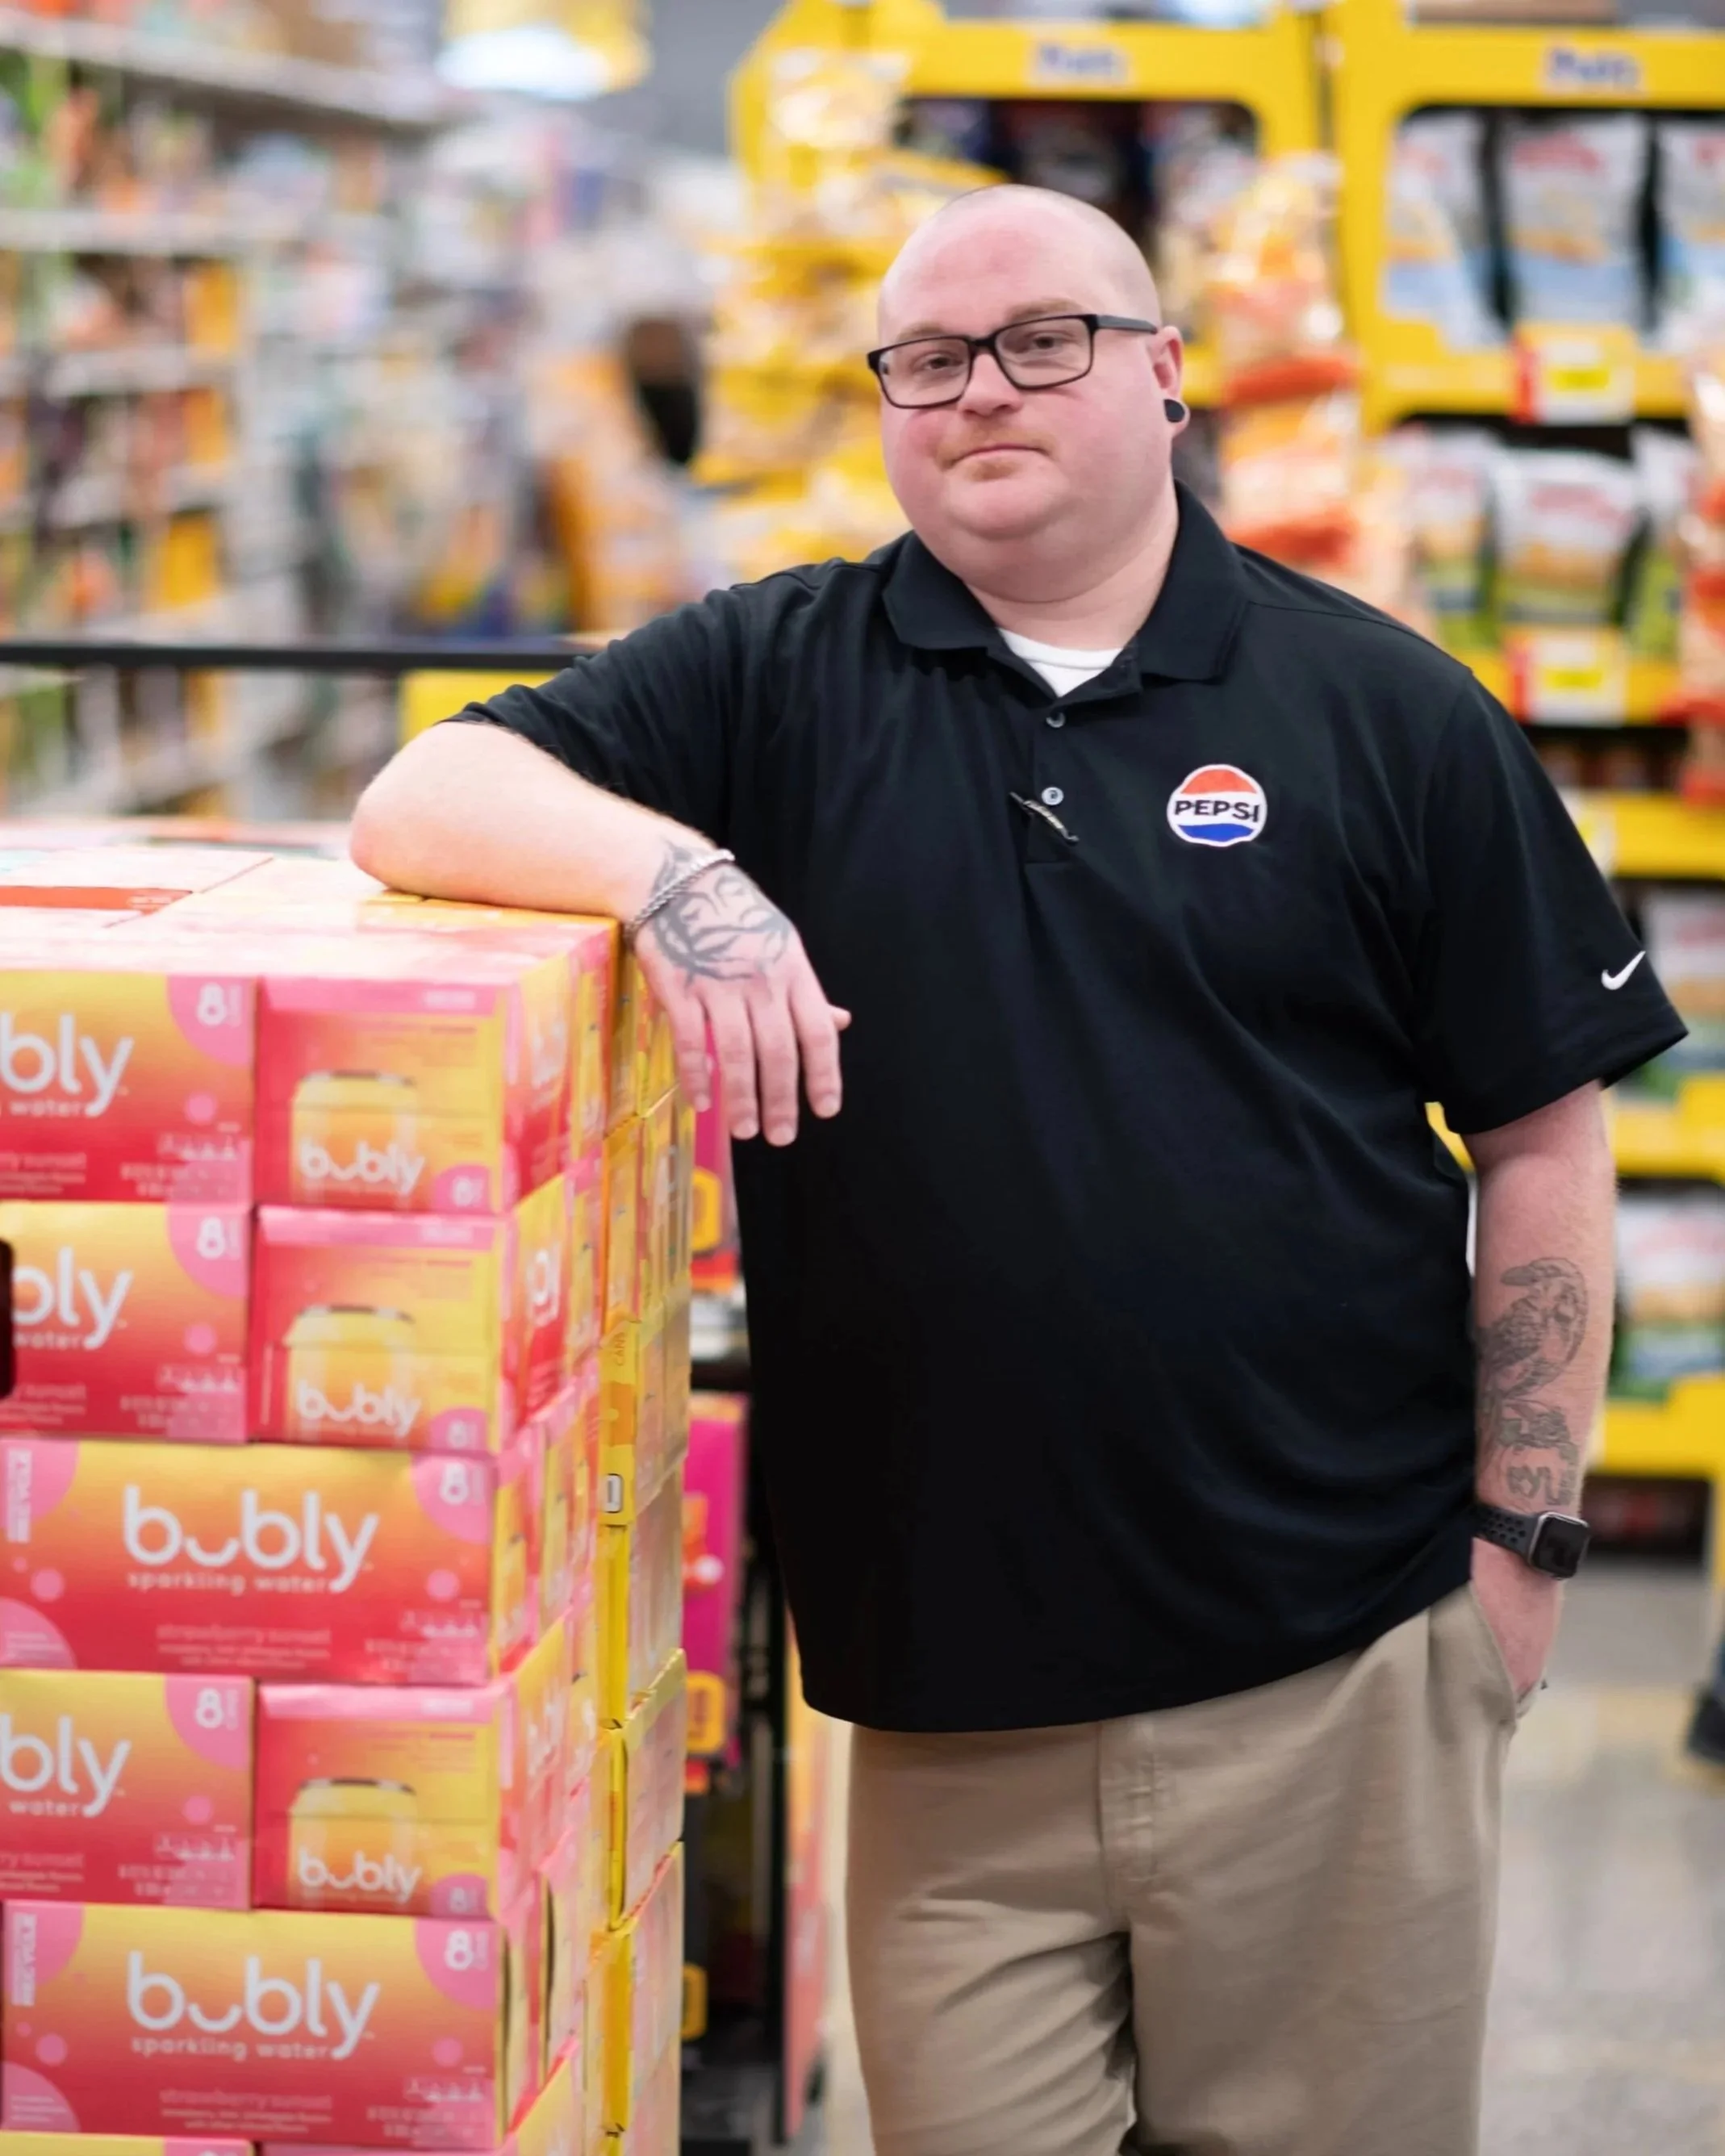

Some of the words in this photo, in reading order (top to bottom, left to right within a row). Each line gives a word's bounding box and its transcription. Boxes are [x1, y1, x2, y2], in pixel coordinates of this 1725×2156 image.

[1174, 800, 1260, 822] PEPSI
[197, 983, 227, 1026] 8
[9, 1101, 85, 1116] water
[299, 1136, 425, 1196] bubly
[197, 1216, 225, 1260] 8
[297, 1378, 422, 1439] bubly
[440, 1462, 469, 1506] 8
[124, 1484, 379, 1593] bubly
[127, 1572, 246, 1597] sparkling
[254, 1576, 329, 1593] water
[195, 1688, 223, 1728] 8
[9, 1800, 81, 1815] water
[298, 1845, 423, 1903] bubly
[445, 1929, 473, 1971] 8
[126, 1949, 381, 2060] bubly
[131, 2037, 247, 2062] sparkling
[256, 2043, 328, 2059] water
